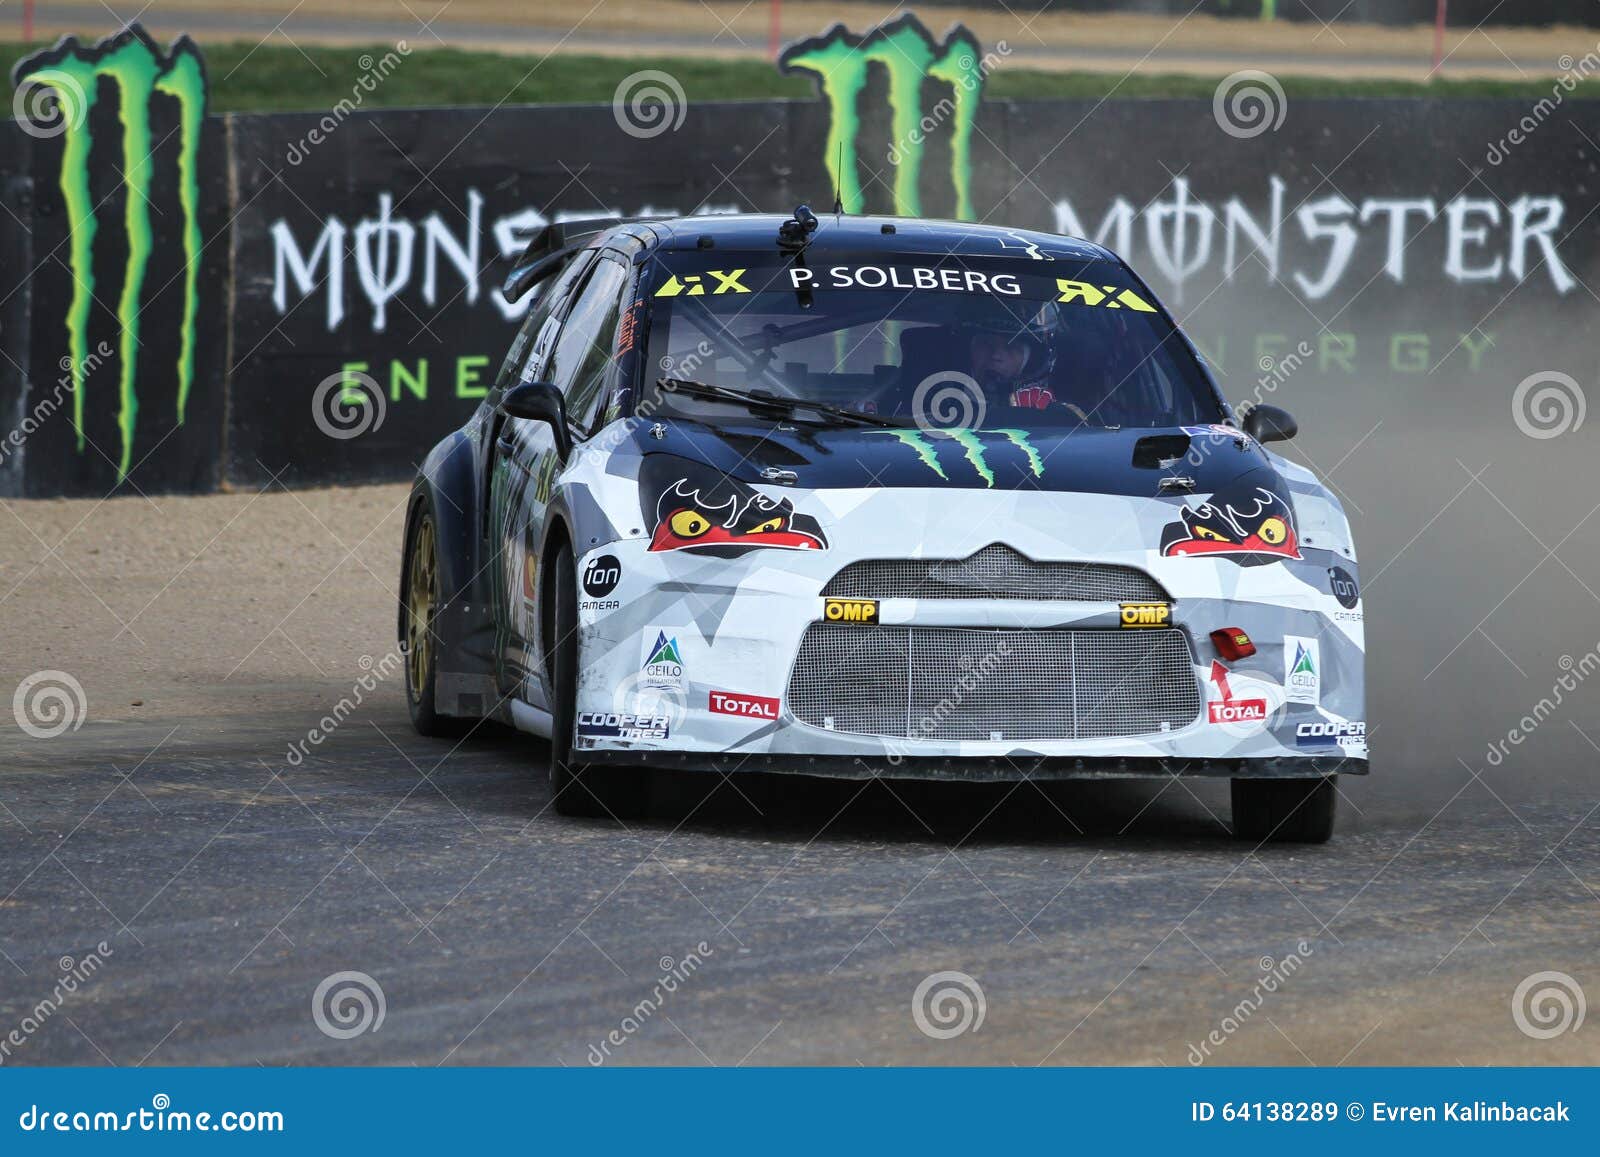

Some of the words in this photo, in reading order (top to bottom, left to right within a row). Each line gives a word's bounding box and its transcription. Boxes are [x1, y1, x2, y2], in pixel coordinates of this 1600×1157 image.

[270, 190, 740, 332] MONS
[790, 268, 820, 288] P.
[829, 266, 1022, 295] SOLBERG
[340, 356, 491, 406] ENE
[826, 602, 876, 621] OMP
[1121, 606, 1169, 624] OMP
[647, 664, 682, 677] GEILO
[578, 712, 669, 729] COOPER
[618, 727, 667, 740] TIRES
[1296, 722, 1366, 737] COOPER
[1335, 735, 1365, 746] TIRES
